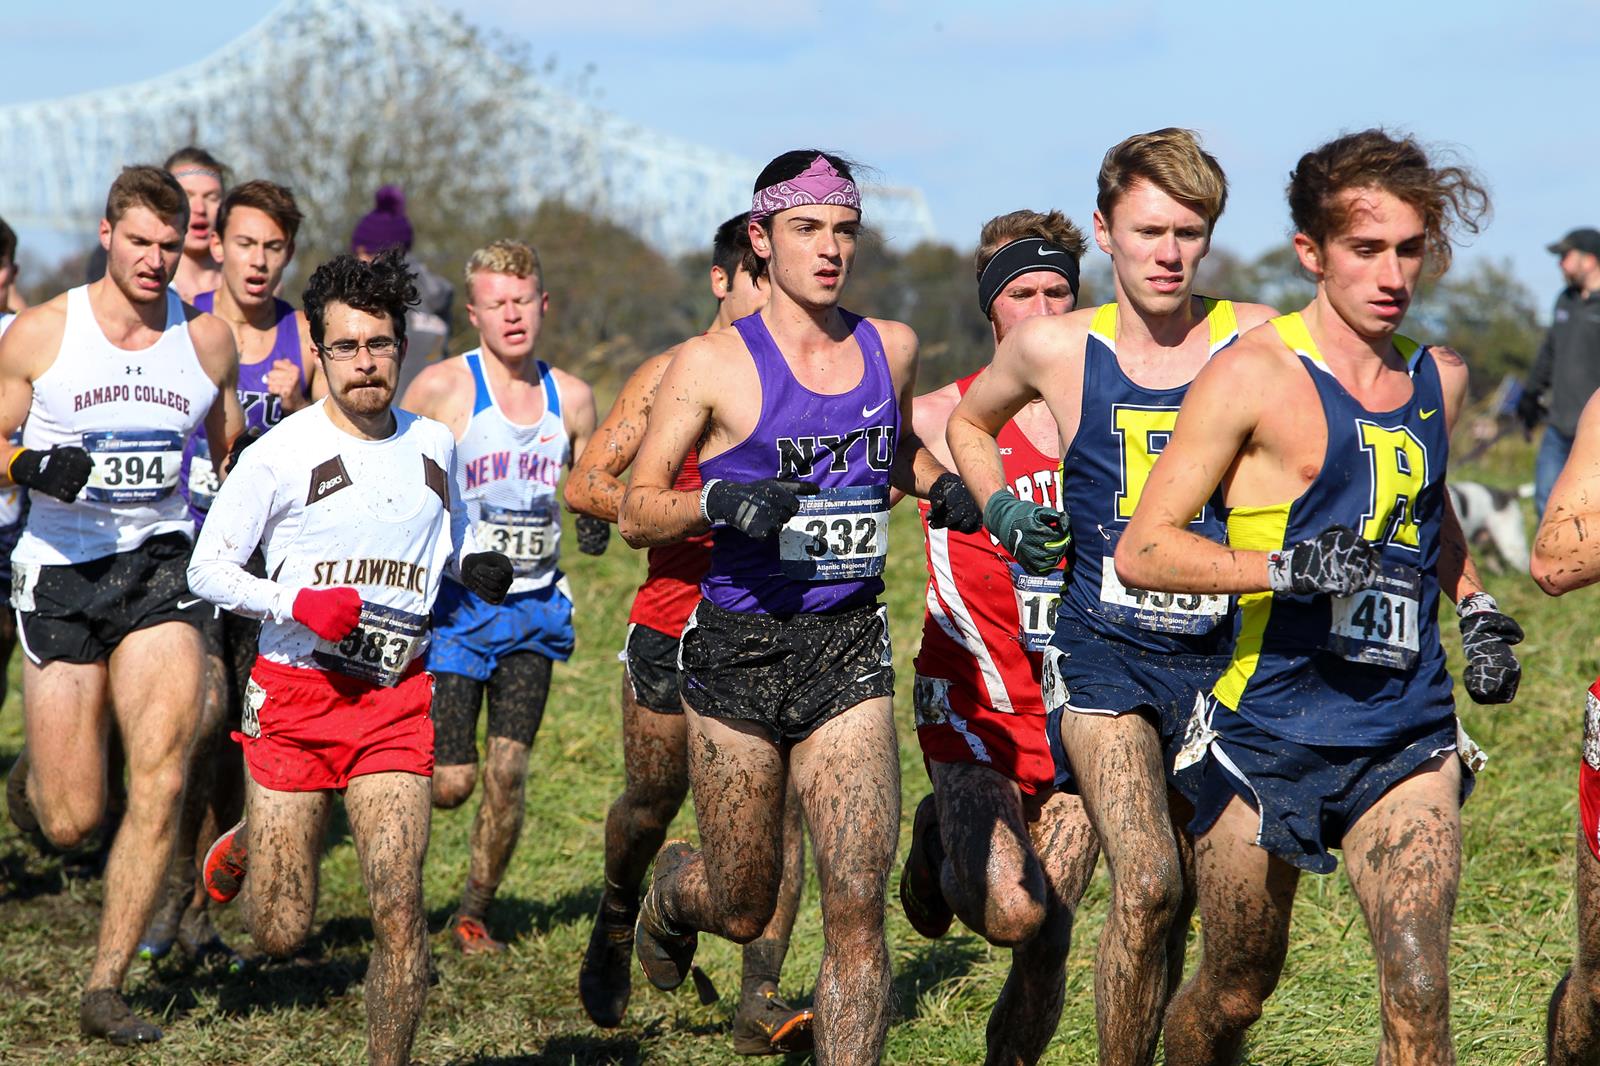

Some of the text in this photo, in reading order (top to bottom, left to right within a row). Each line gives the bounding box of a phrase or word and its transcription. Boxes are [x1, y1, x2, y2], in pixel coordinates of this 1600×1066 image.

[74, 385, 190, 415] RAMAPO COLLEGE
[236, 390, 283, 428] YU
[104, 456, 165, 486] 394
[776, 426, 894, 478] NYU
[465, 451, 511, 492] NEW
[1355, 418, 1430, 552] R
[492, 529, 545, 556] 315
[805, 517, 877, 557] 332
[313, 558, 426, 595] ST. LAWRENC
[816, 562, 867, 571] Atlantic Regional
[1351, 594, 1406, 643] 431
